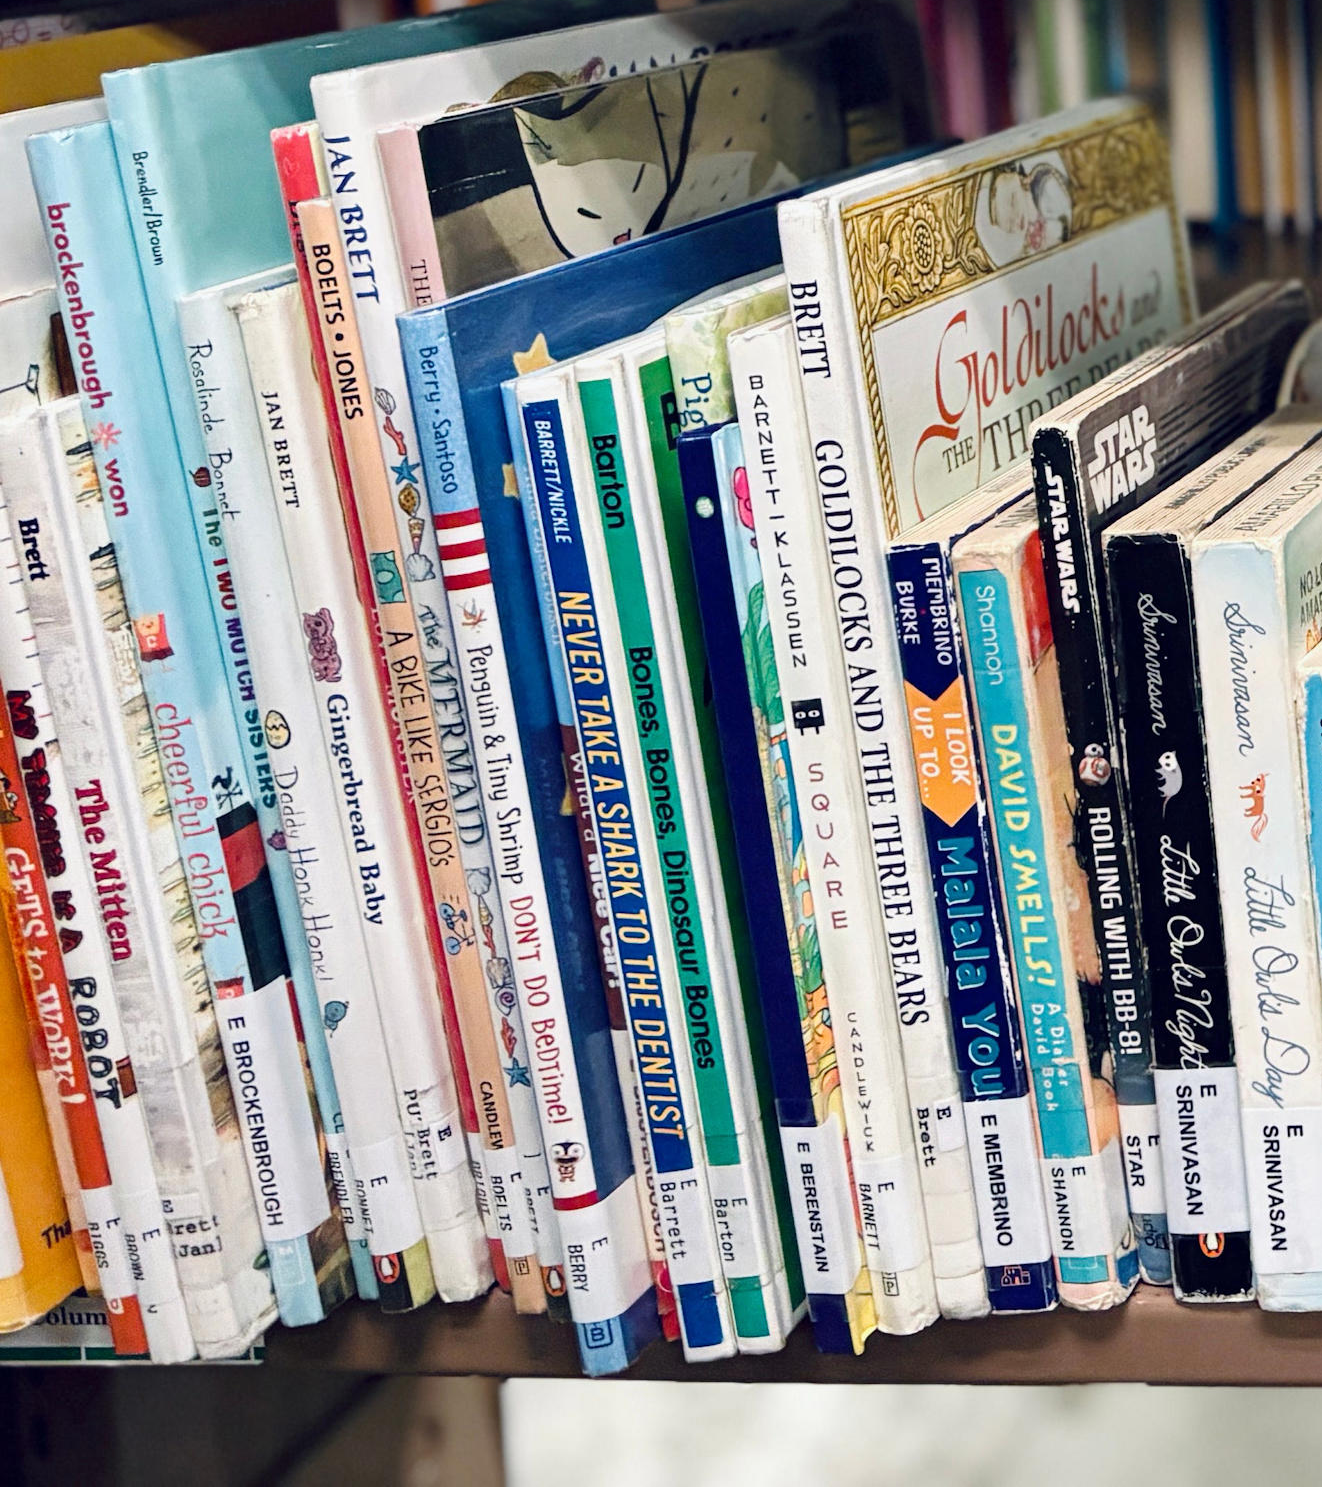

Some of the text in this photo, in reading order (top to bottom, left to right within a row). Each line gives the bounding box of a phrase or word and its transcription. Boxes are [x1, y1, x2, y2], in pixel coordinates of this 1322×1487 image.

[322, 135, 380, 305] JAN BRETT
[47, 202, 105, 411] brockenbrough
[311, 242, 363, 421] BOELTS JONES
[789, 280, 830, 378] BRETT
[534, 419, 572, 544] BARRETT/NICKLE
[591, 434, 625, 529] Barton
[1088, 404, 1156, 514] STAR WARS
[895, 580, 921, 645] BURKE
[921, 557, 952, 666] MEMBRINO
[975, 585, 1002, 686] Shannon
[1137, 591, 1176, 736] Srinivasan
[466, 644, 498, 729] Penguin
[485, 735, 506, 750] &
[814, 440, 930, 1027] GOLDILOCKS AND THE THREE BEARS
[326, 693, 383, 925] Gingerbread Baby
[484, 752, 512, 803] Tiny
[74, 779, 133, 961] The Mitten
[496, 807, 524, 888] Shrimp
[557, 591, 684, 1140] NEVER TAKE A SHARK TO THE DENTIST
[629, 646, 714, 1069] Bones, Bones, Dinosaur Bones
[991, 724, 1055, 988] DAVID SMELLS!
[510, 898, 541, 963] DON'T
[523, 975, 550, 1007] DO
[1088, 807, 1142, 1057] ROLLING WITH BB-8!
[1160, 834, 1213, 1069] Little Owl's Night
[231, 1038, 283, 1227] BROCKENBROUGH
[982, 1133, 1012, 1247] MEMBRINO
[1175, 1084, 1204, 1216] SRINIVASAN
[1262, 1124, 1288, 1252] SRINIVASAN
[800, 1163, 830, 1273] BERENSTAIN
